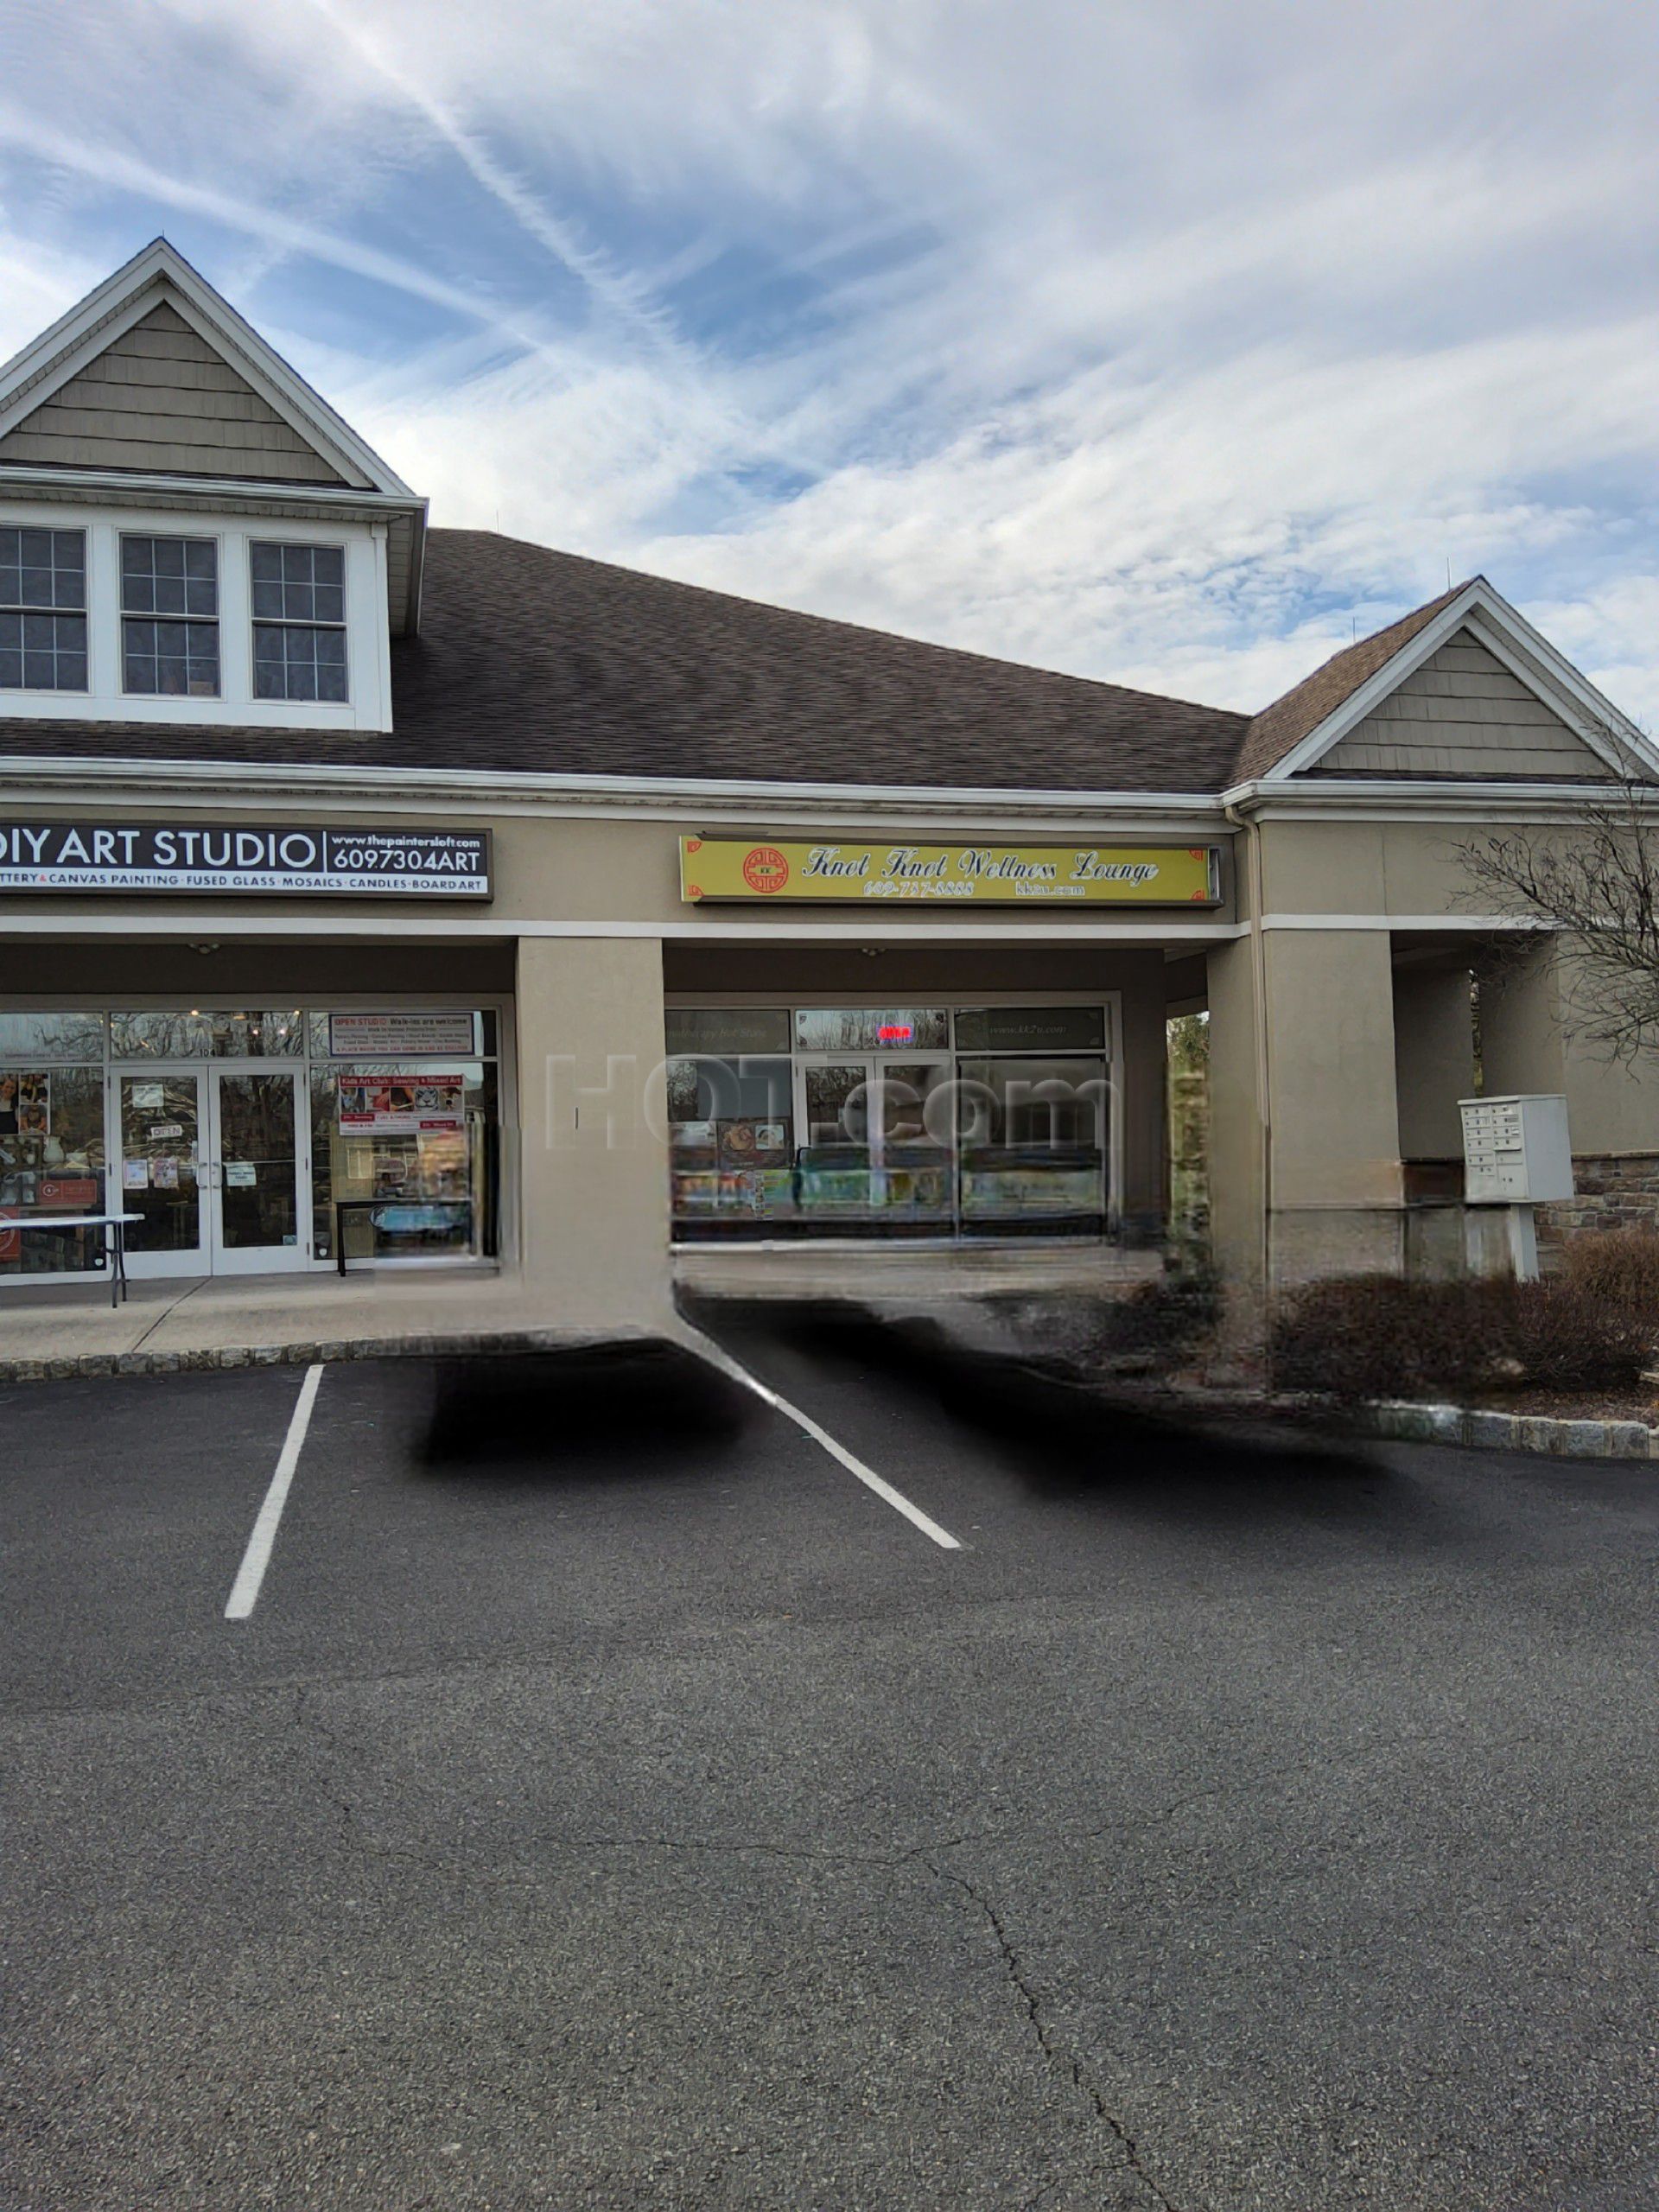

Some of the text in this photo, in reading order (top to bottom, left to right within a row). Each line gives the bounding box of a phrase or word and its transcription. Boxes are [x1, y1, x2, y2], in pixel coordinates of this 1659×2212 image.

[0, 827, 316, 868] IY ART STUDIO
[332, 834, 480, 849] www.thepaintersloft.com
[760, 866, 771, 874] KK
[802, 846, 1159, 887] Knot Knot Wellness Lounge
[49, 873, 106, 884] CANVAS
[111, 874, 178, 886] PAINTING
[187, 875, 227, 886] FUSED
[232, 875, 276, 887] GLASS
[283, 877, 342, 888] MOSAICS
[349, 878, 407, 888] CANDLES
[412, 880, 456, 889] BOARD
[458, 880, 481, 890] ART
[200, 1048, 215, 1057] 104
[393, 1077, 421, 1086] Sewing
